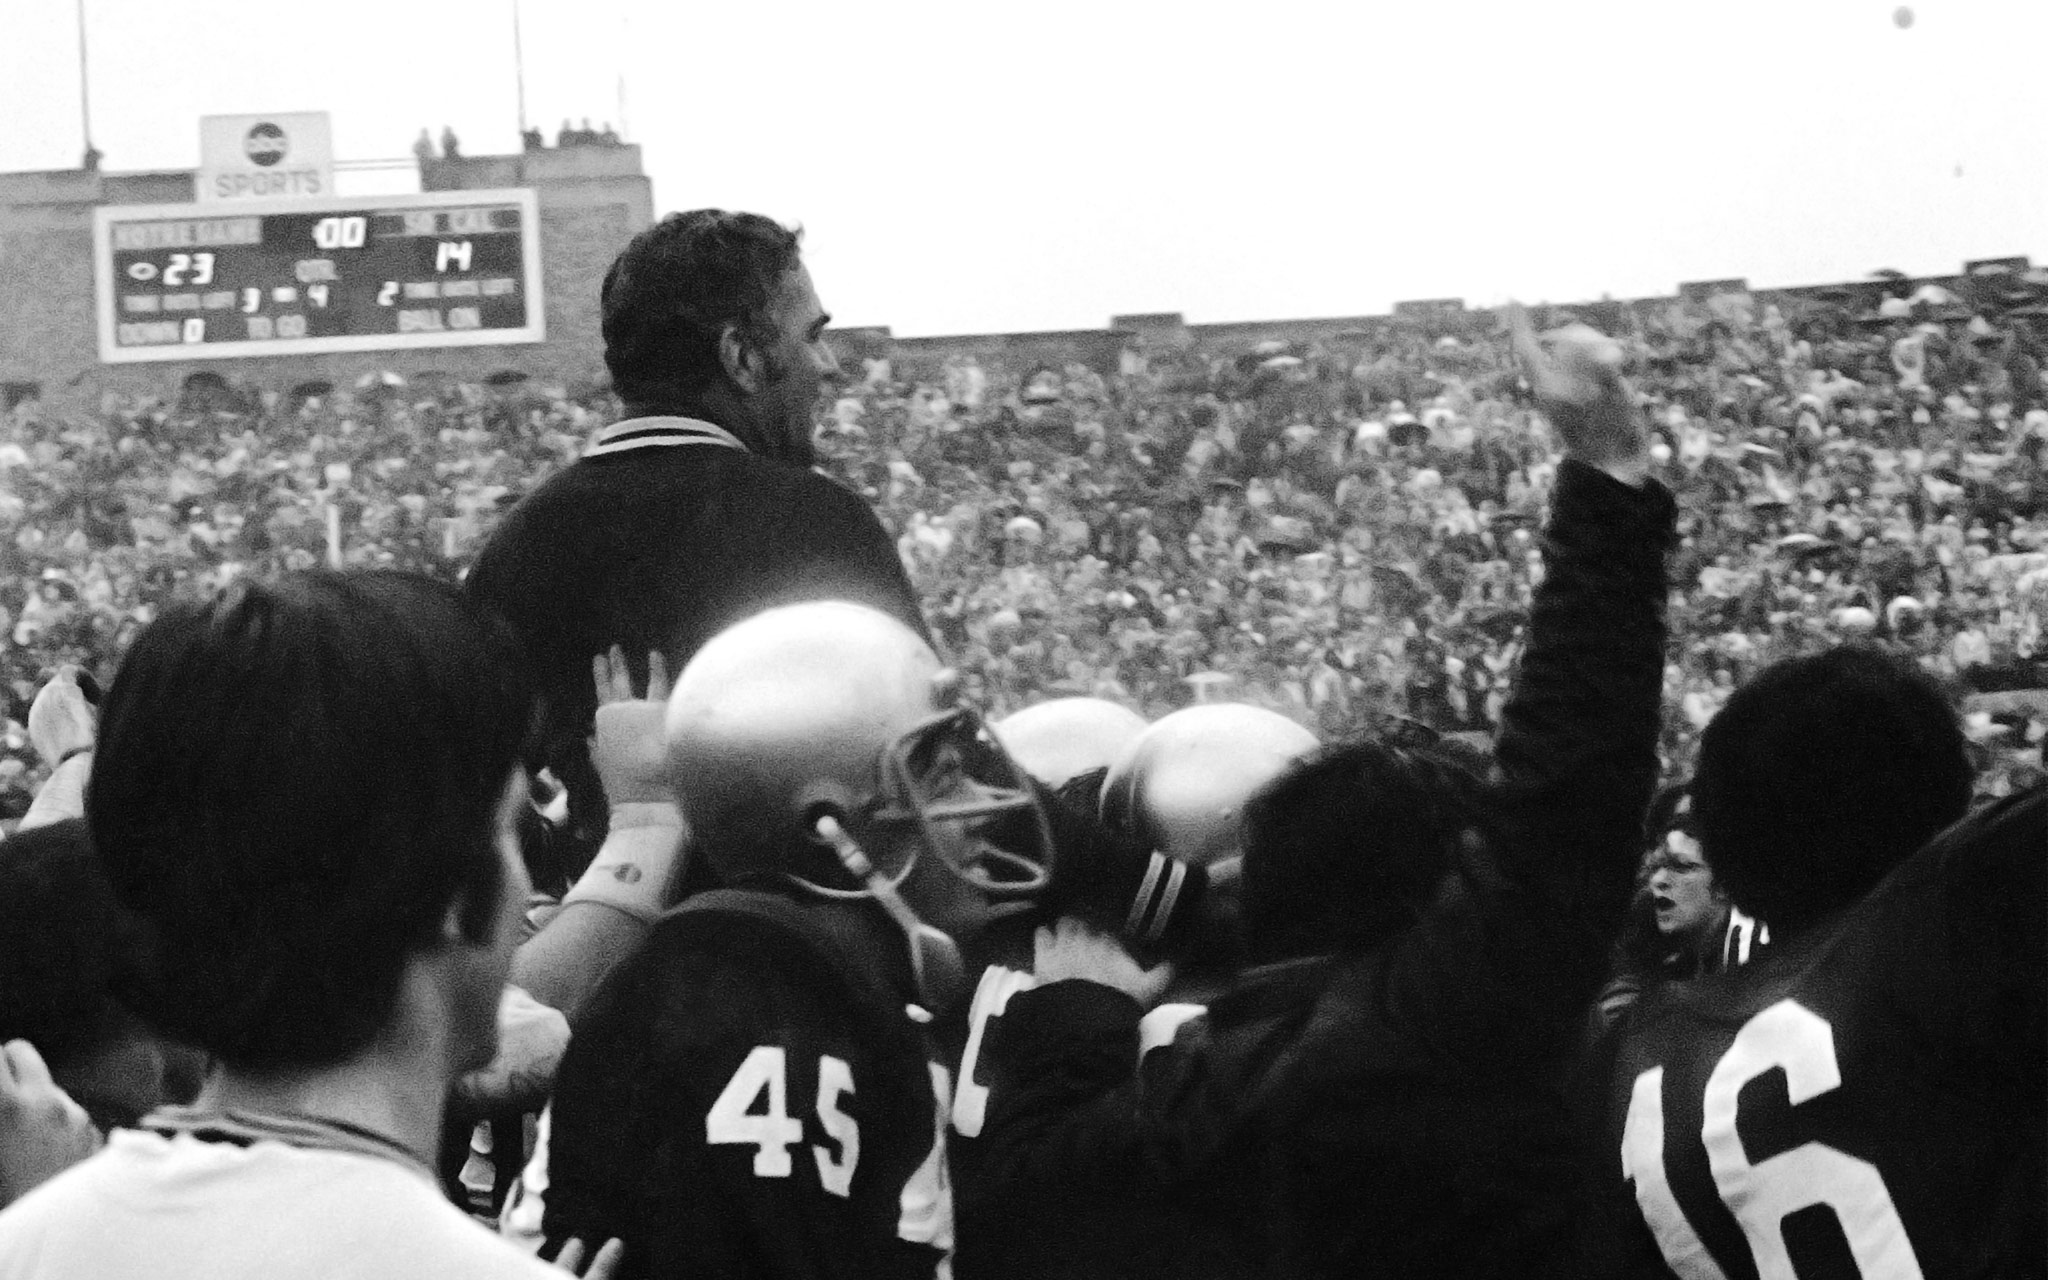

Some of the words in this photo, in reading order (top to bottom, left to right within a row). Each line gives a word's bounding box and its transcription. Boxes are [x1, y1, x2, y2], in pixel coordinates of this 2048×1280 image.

[216, 170, 321, 197] SPORTS
[163, 252, 215, 286] 23
[435, 241, 473, 273] 14
[376, 281, 400, 307] 2
[706, 1046, 860, 1198] 45
[1620, 998, 1925, 1280] 16
